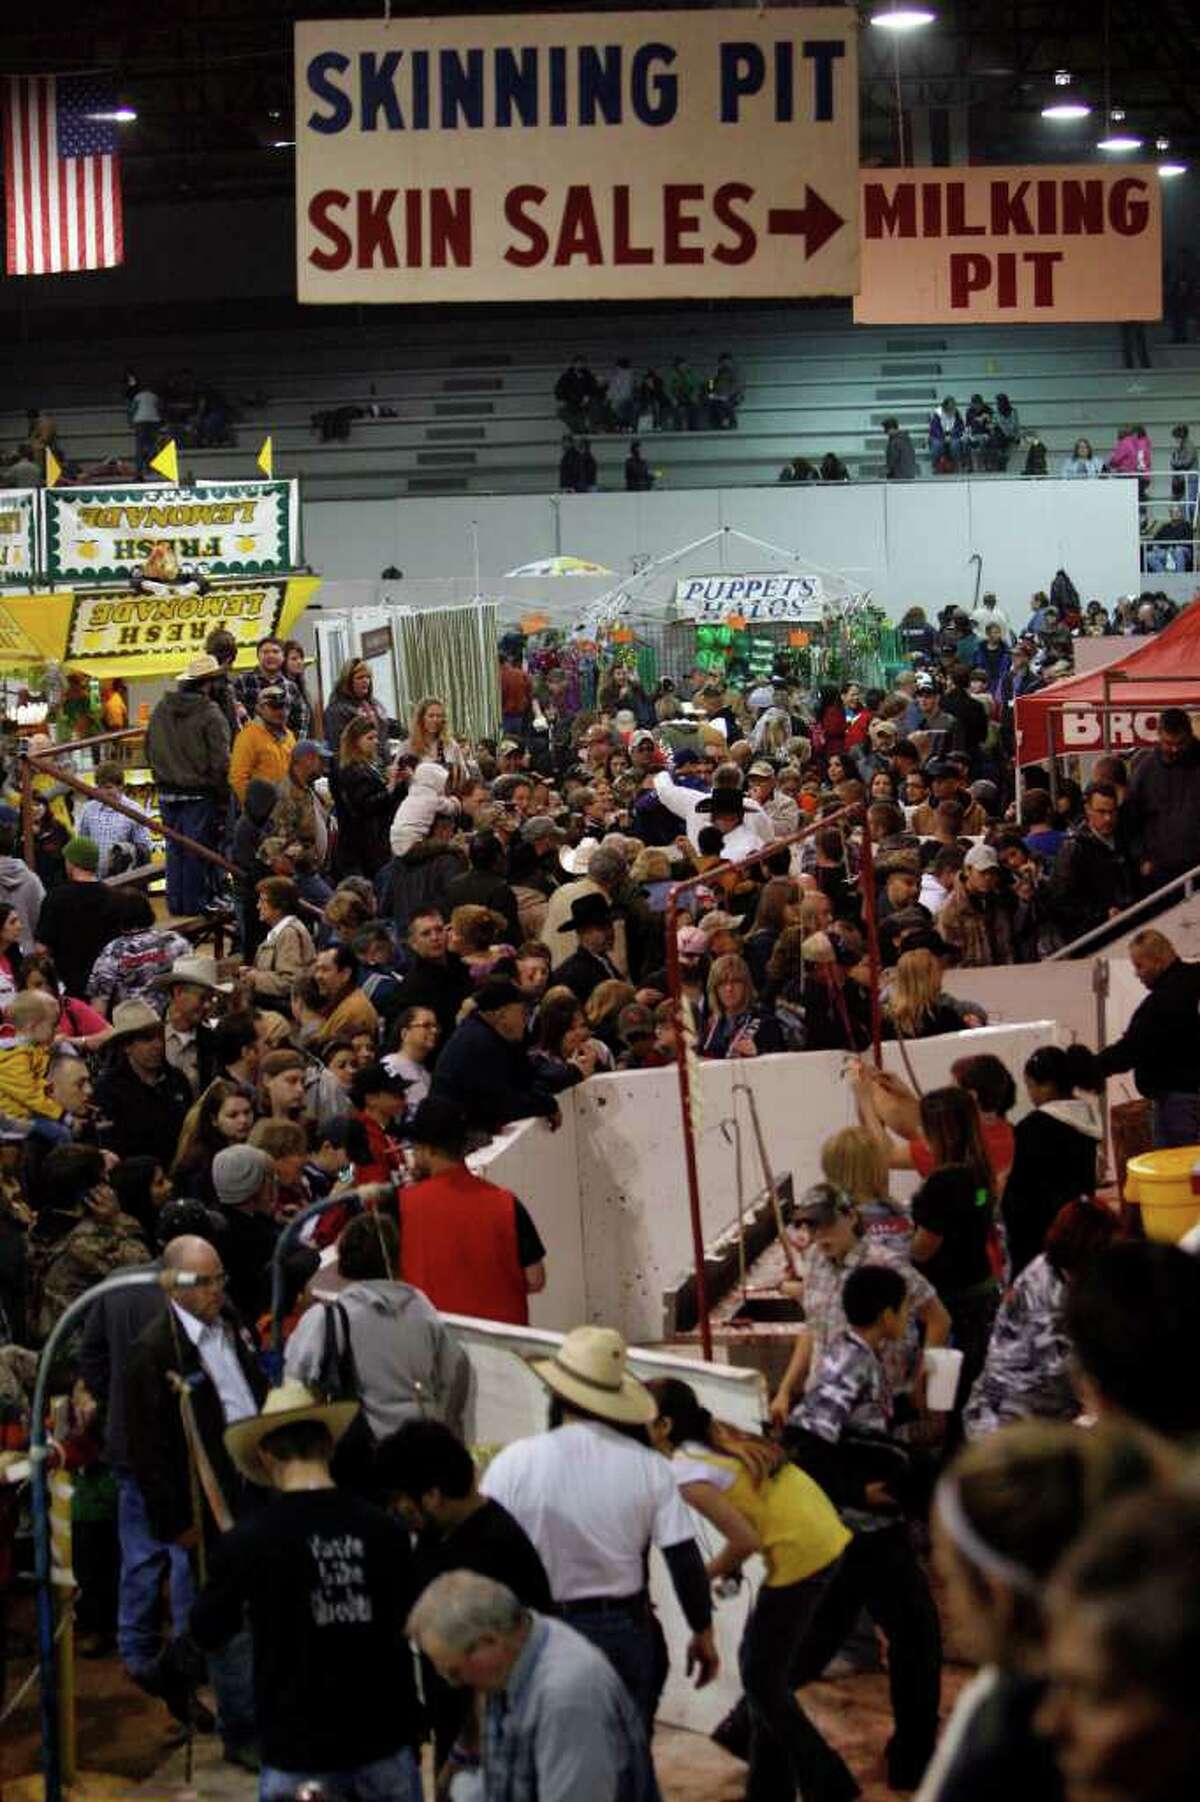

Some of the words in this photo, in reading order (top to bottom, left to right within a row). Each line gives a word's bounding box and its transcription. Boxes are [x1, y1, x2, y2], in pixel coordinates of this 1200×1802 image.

[307, 42, 678, 134] SKINNING
[720, 40, 846, 123] PIT
[308, 188, 472, 272] SKIN
[504, 182, 757, 267] SALES
[863, 177, 1150, 240] MILKING
[950, 252, 1063, 309] PIT
[90, 594, 264, 624] LEMONADE
[685, 578, 816, 600] PUPPETS
